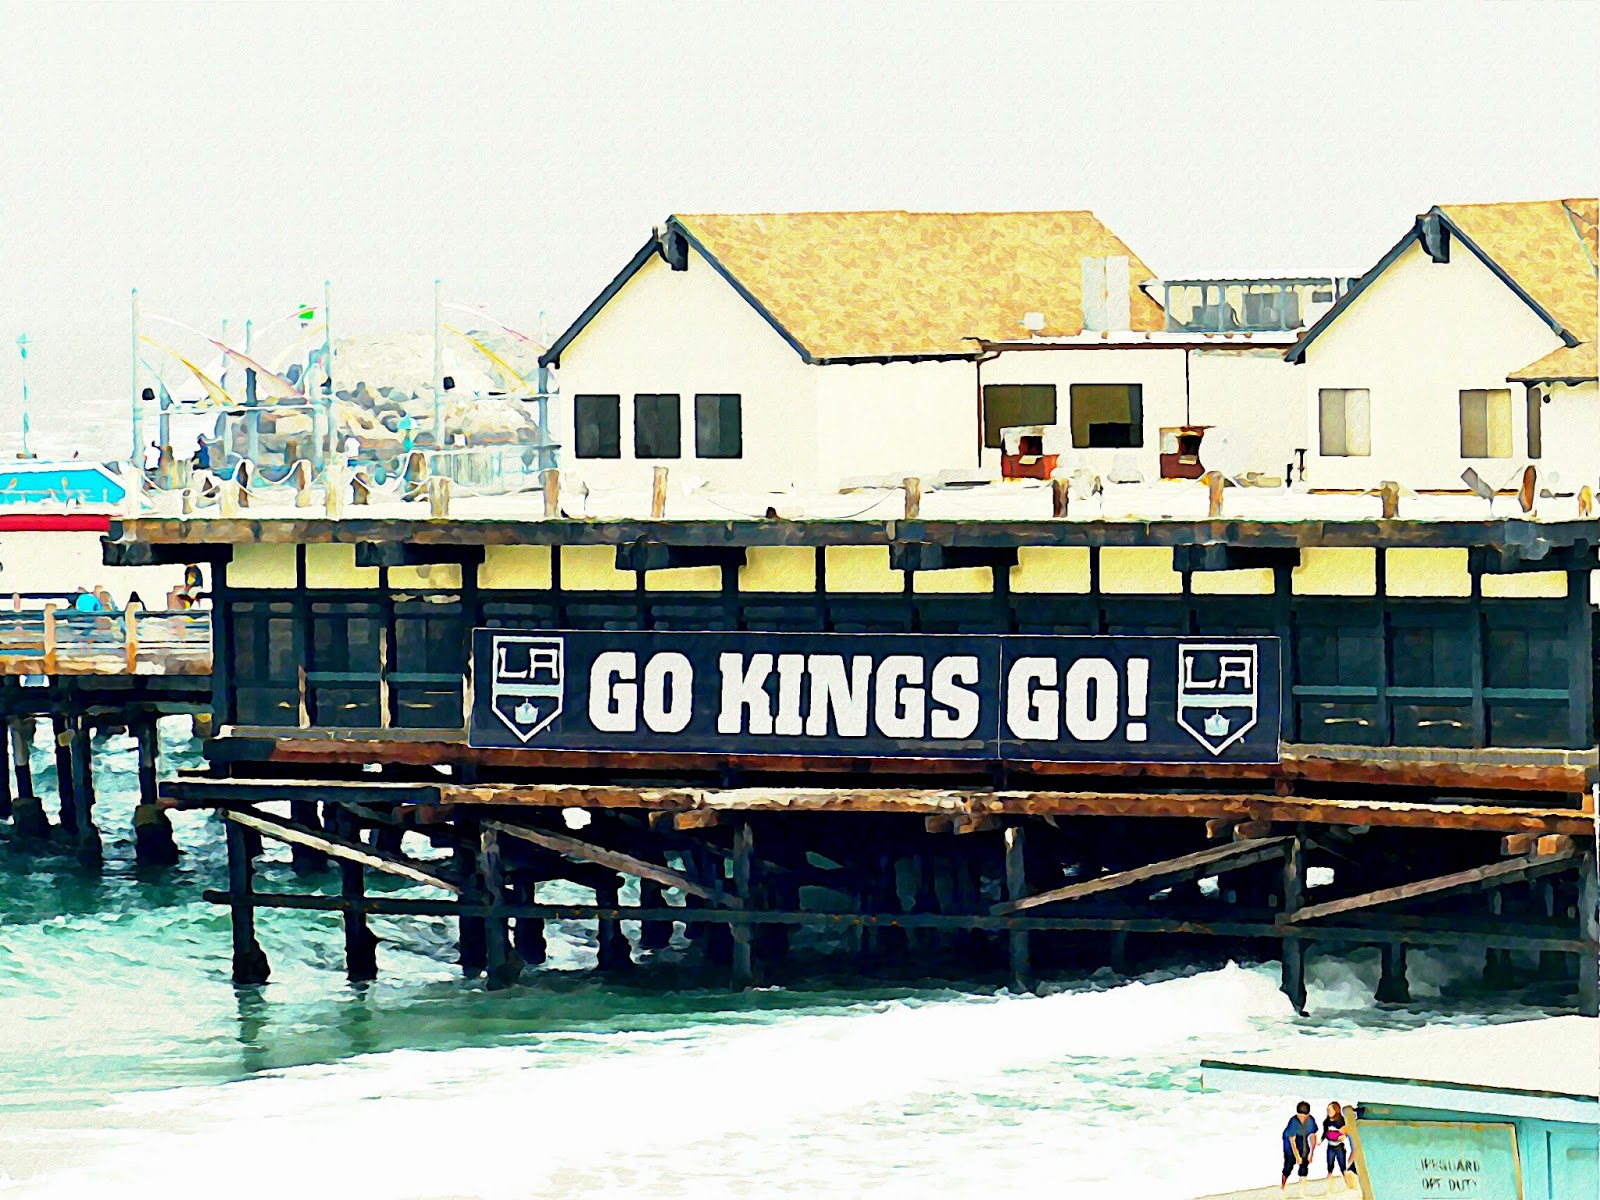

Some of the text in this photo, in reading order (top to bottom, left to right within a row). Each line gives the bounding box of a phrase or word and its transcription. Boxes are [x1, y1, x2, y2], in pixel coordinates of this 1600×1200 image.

[498, 647, 559, 679] LA
[1184, 656, 1252, 689] LA
[588, 651, 1150, 742] GO KINGS GO!
[1448, 1178, 1478, 1192] DUTY
